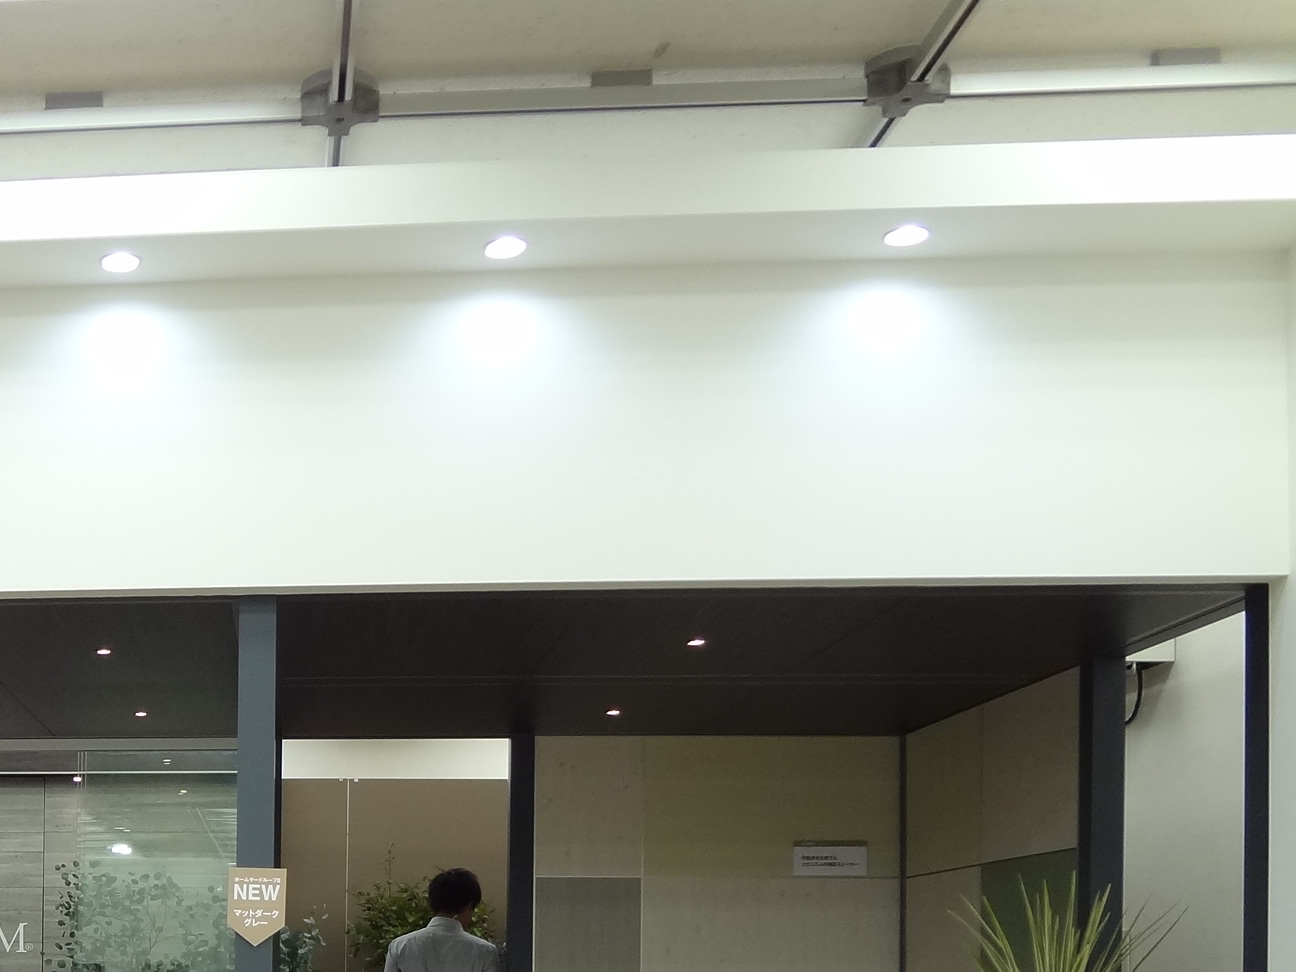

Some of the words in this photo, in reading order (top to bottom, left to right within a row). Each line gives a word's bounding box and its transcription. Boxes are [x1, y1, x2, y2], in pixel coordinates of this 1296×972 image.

[233, 883, 280, 901] NEW
[233, 909, 280, 919] マットダーク
[244, 918, 268, 927] グレー
